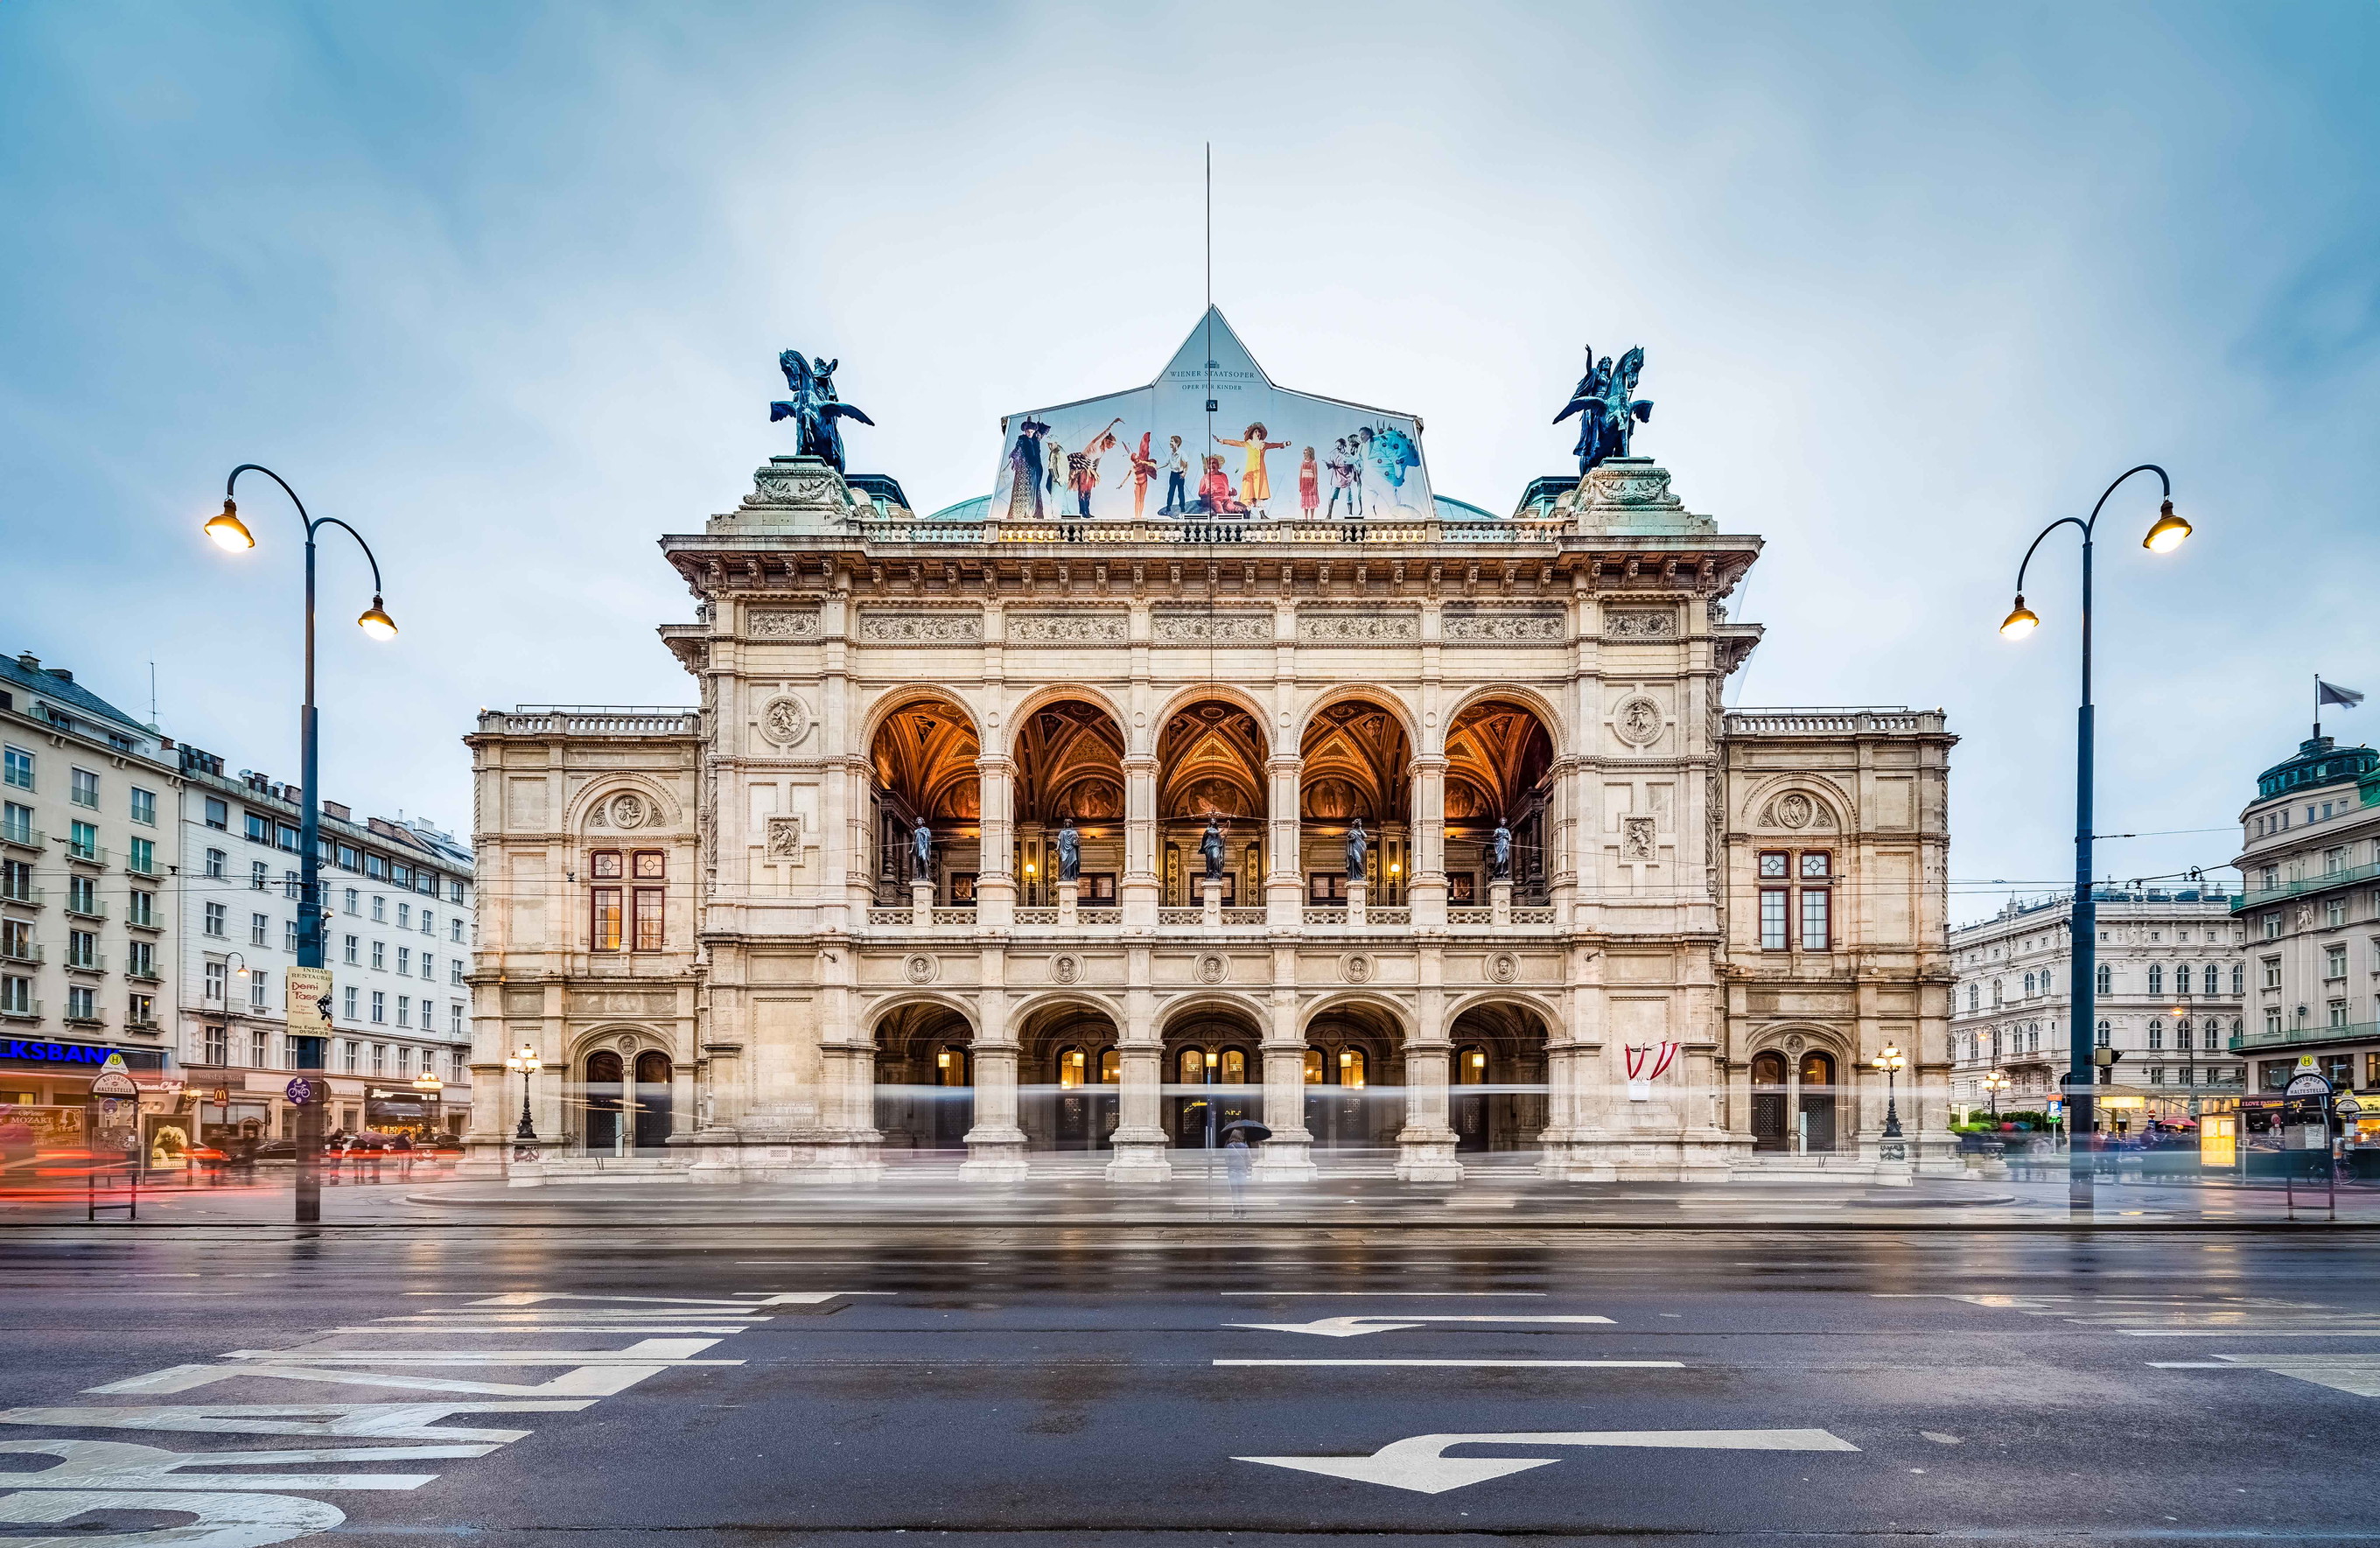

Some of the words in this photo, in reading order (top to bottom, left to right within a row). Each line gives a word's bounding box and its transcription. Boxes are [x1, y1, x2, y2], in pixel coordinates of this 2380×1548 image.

[291, 982, 318, 991] Demi
[292, 991, 318, 1001] Tass
[102, 1075, 129, 1084] AUTOBUS
[2294, 1076, 2321, 1085] AUTOBUS
